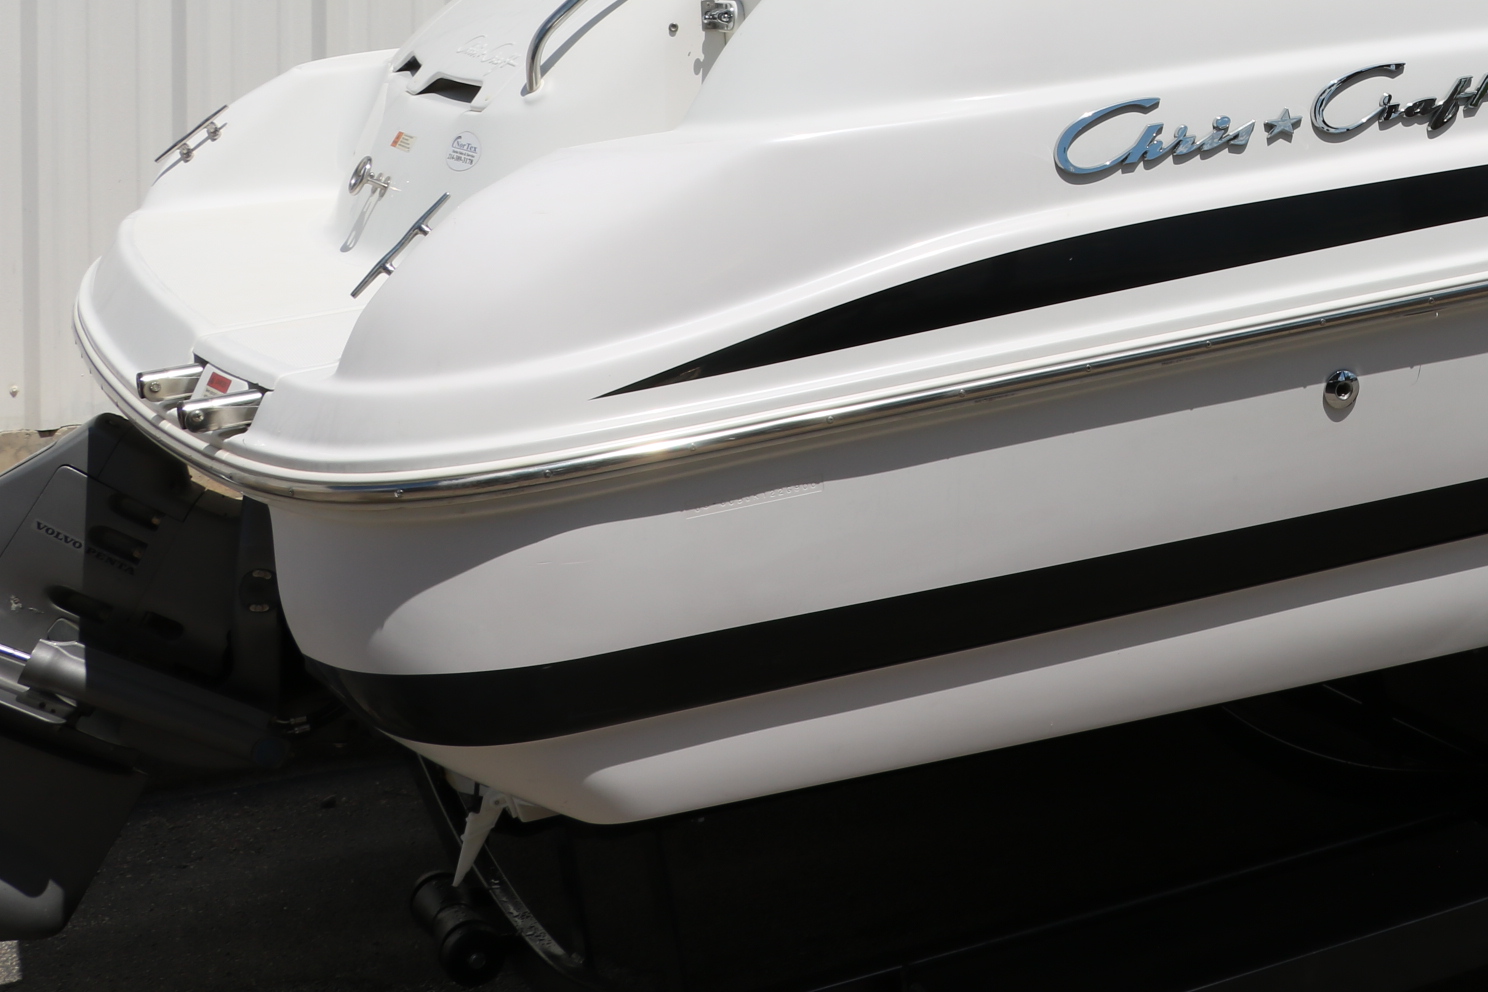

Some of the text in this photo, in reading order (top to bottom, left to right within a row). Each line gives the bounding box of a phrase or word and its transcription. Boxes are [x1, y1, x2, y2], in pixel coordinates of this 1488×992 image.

[1053, 97, 1256, 175] Chris
[36, 520, 135, 576] VOLVO PENTA
